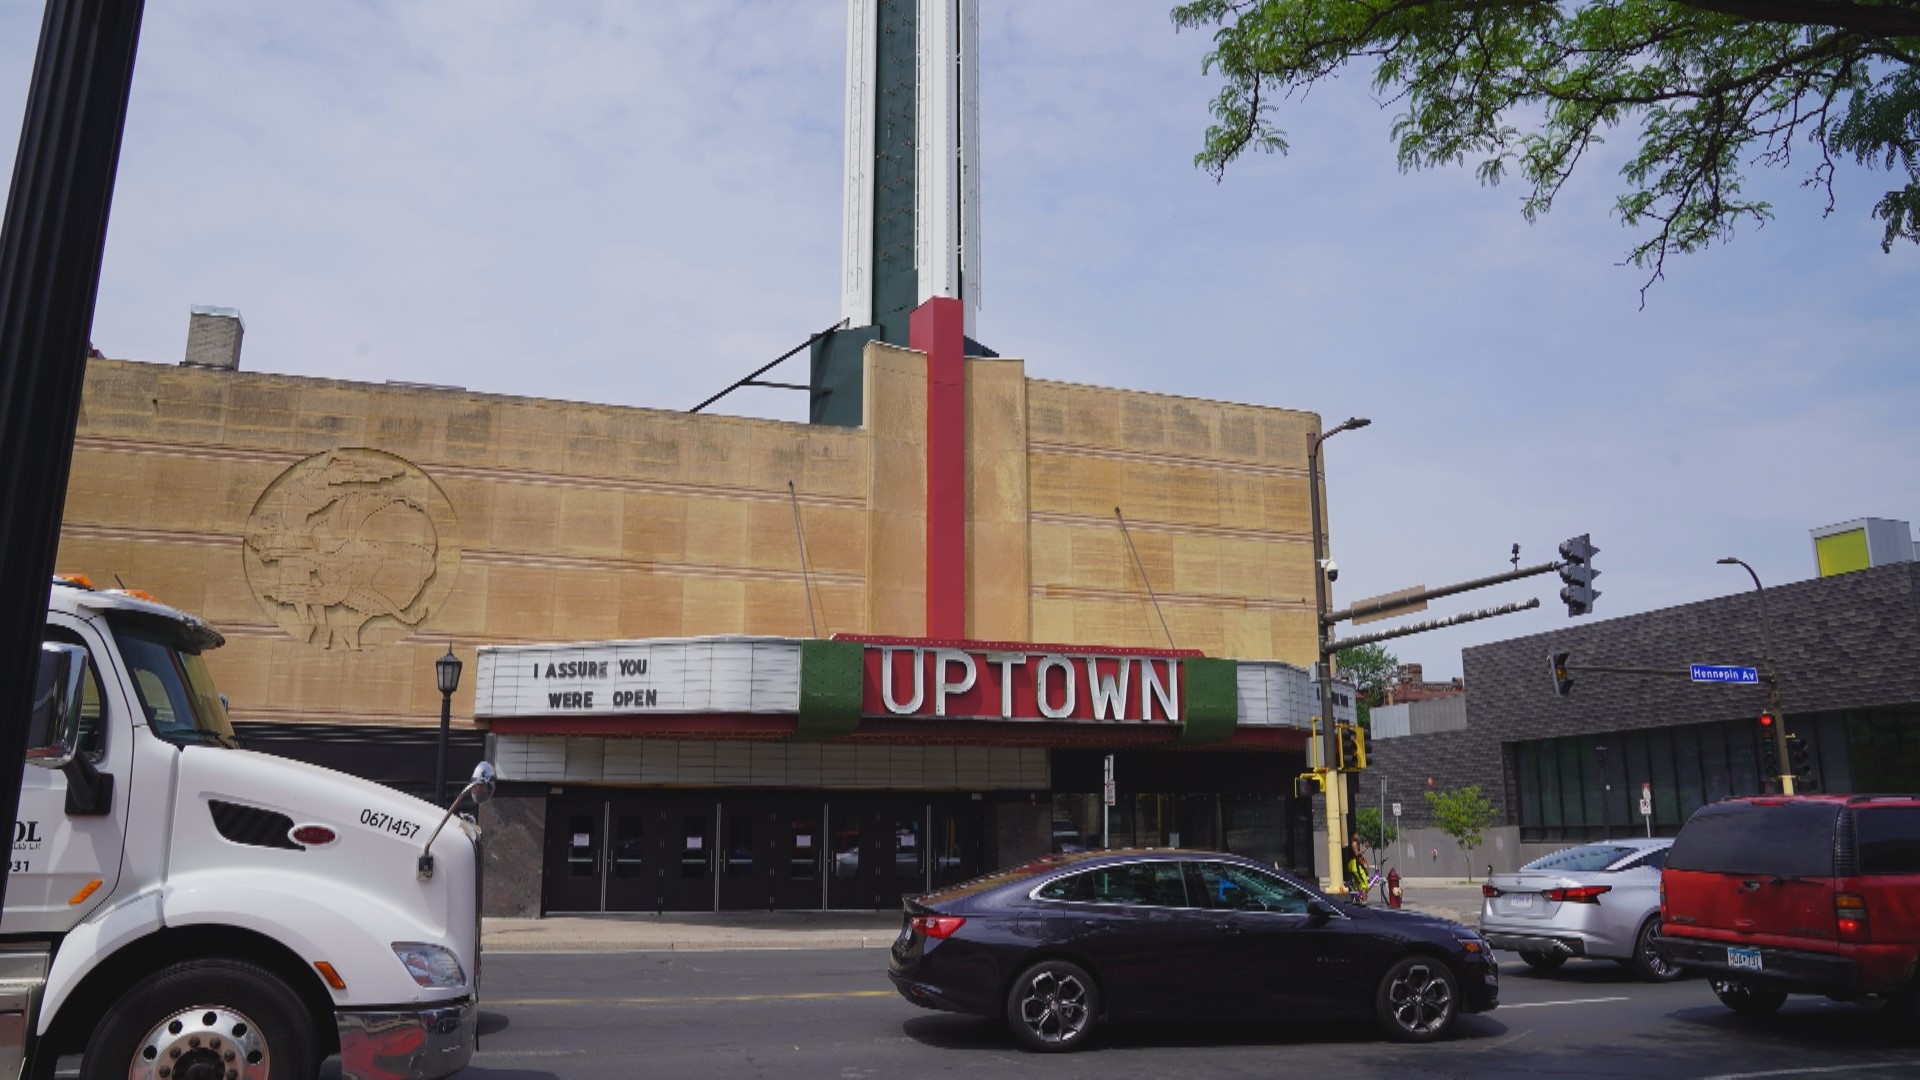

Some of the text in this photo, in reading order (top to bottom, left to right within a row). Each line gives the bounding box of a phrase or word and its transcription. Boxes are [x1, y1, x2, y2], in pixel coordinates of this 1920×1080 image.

[533, 659, 648, 678] I ASSURE YOU
[1693, 667, 1754, 680] Hennepin Av
[882, 648, 1179, 721] UPTOWN
[548, 689, 657, 708] WERE OPEN
[360, 809, 420, 838] 0671457
